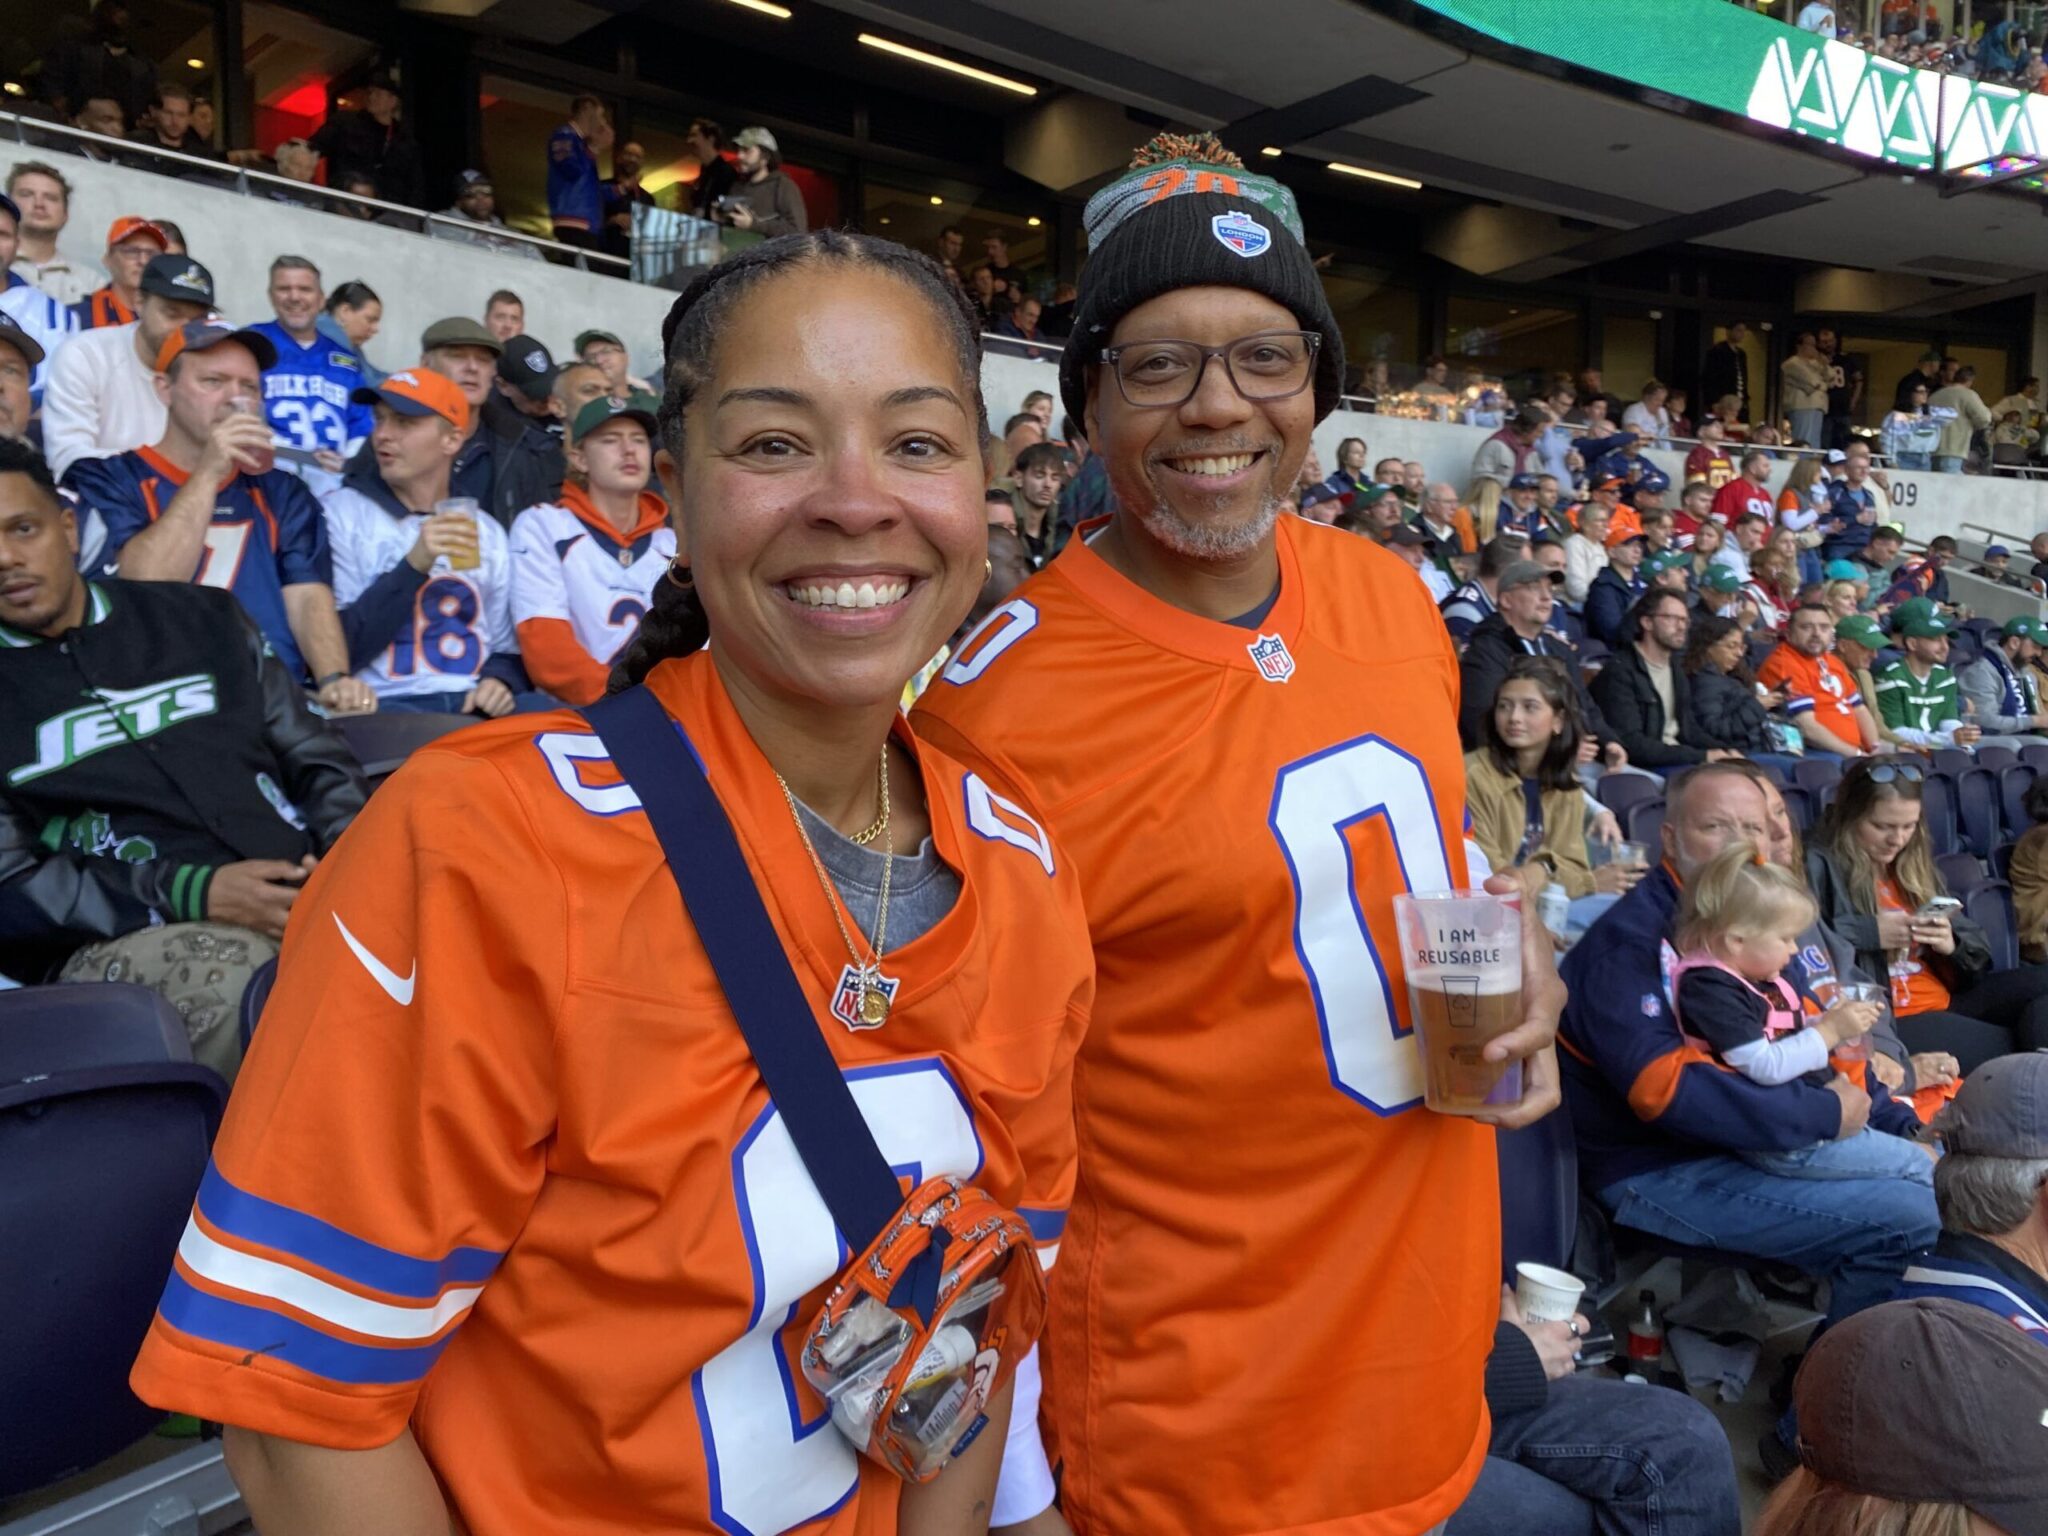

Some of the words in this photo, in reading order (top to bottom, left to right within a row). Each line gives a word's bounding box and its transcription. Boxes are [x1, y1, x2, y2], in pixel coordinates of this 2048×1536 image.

[1221, 228, 1263, 241] LONDON
[269, 400, 348, 457] 33
[388, 575, 482, 679] 18
[941, 597, 1040, 687] 0
[1261, 649, 1291, 676] NFL
[8, 673, 218, 787] JETS
[961, 770, 1056, 878] 0
[1267, 732, 1458, 1118] 0
[1417, 949, 1501, 964] REUSABLE
[1450, 929, 1476, 942] AM
